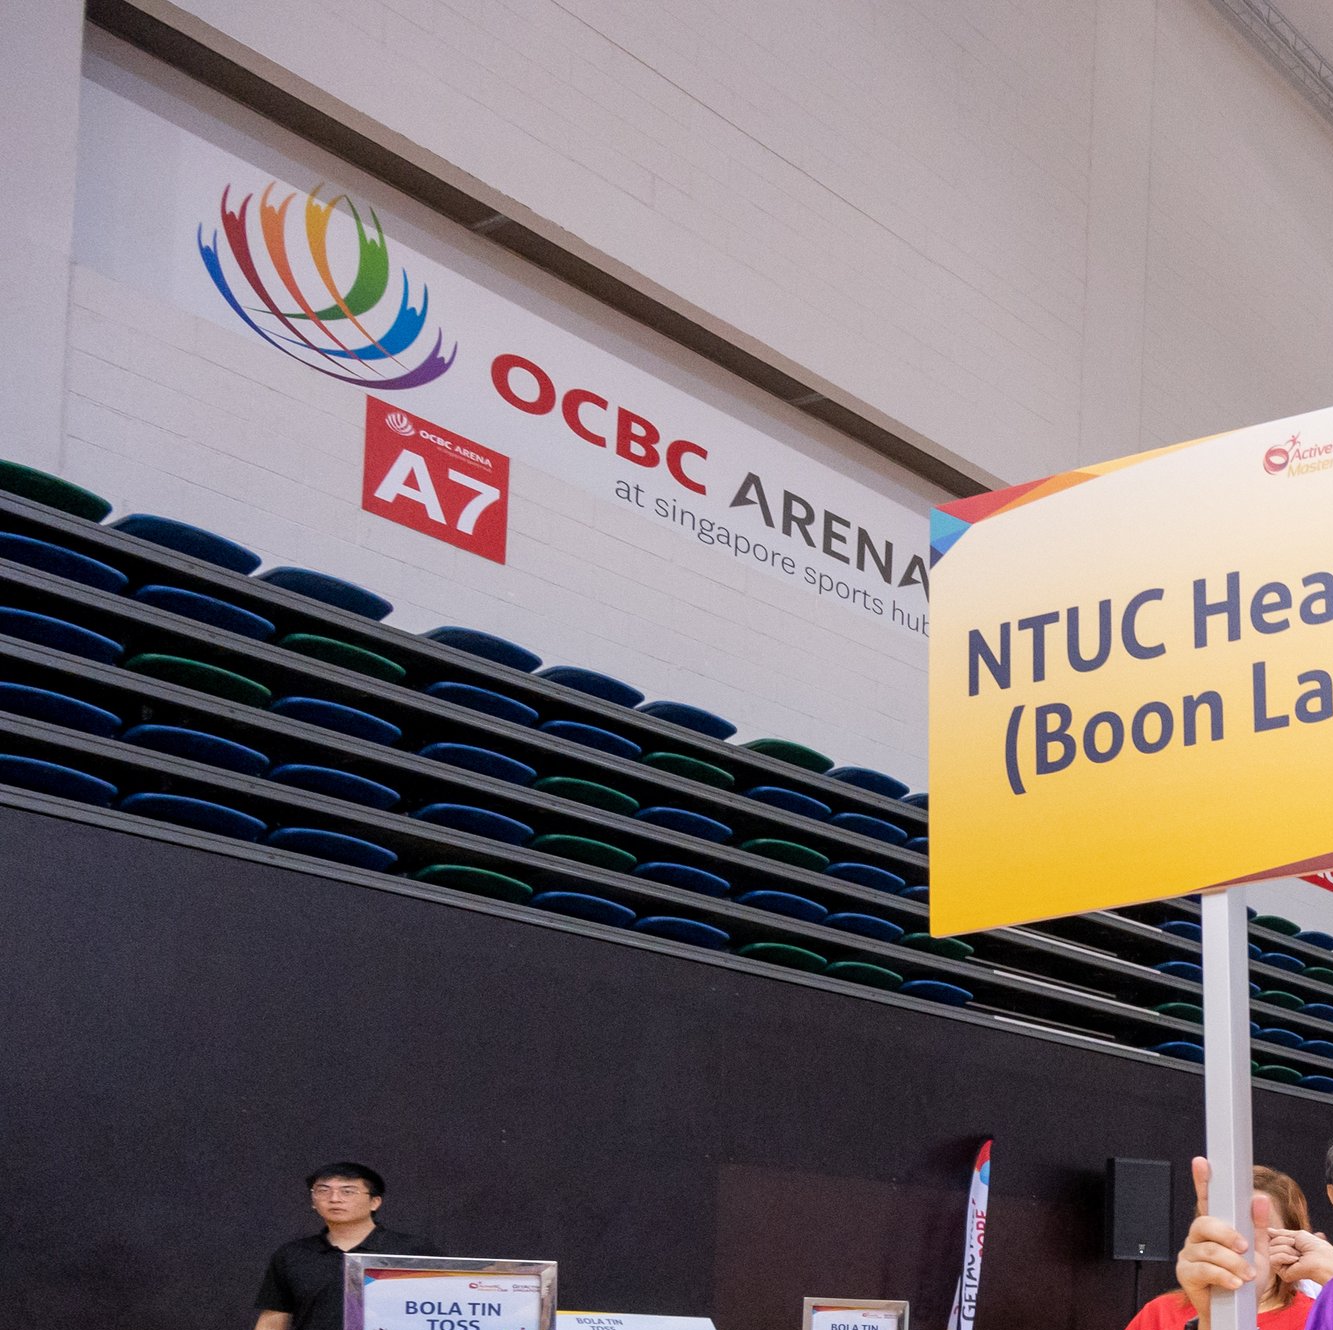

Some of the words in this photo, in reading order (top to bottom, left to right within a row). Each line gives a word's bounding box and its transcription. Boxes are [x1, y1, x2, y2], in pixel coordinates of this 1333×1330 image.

[373, 448, 501, 536] A7
[419, 430, 453, 450] OCBC
[455, 445, 493, 468] ARENA
[490, 353, 708, 495] OCBC
[729, 472, 930, 603] ARENA
[615, 477, 645, 509] at
[655, 499, 796, 575] singapore
[804, 565, 884, 616] sports
[969, 588, 1167, 697] NTUC
[1004, 683, 1225, 796] (Boon
[405, 1301, 463, 1316] BOLA
[468, 1302, 502, 1317] TIN
[576, 1317, 604, 1326] BOLA
[605, 1318, 624, 1326] TIN
